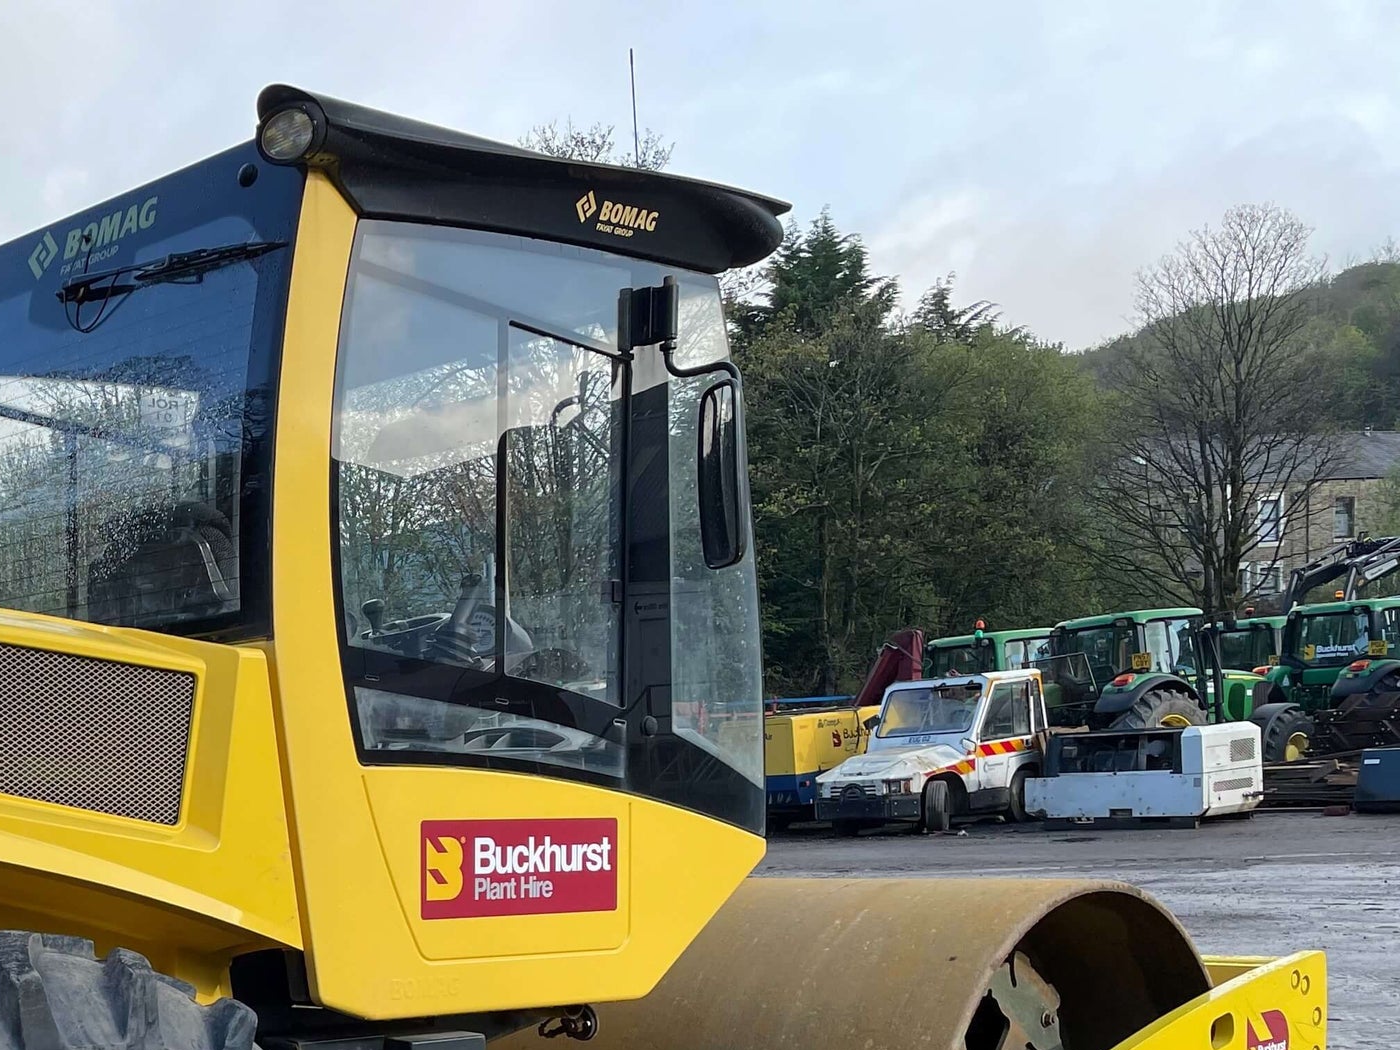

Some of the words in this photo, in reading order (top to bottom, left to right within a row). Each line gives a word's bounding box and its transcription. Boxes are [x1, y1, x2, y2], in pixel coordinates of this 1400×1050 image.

[63, 196, 158, 260] BOMAG
[599, 201, 659, 231] BOMAG
[596, 223, 613, 233] FAYAT
[614, 227, 634, 237] GROUP
[88, 245, 119, 265] GROUP
[1316, 644, 1356, 653] Buckhurst
[474, 836, 611, 874] Buckhurst
[474, 877, 516, 901] Plant
[520, 875, 553, 899] Hire
